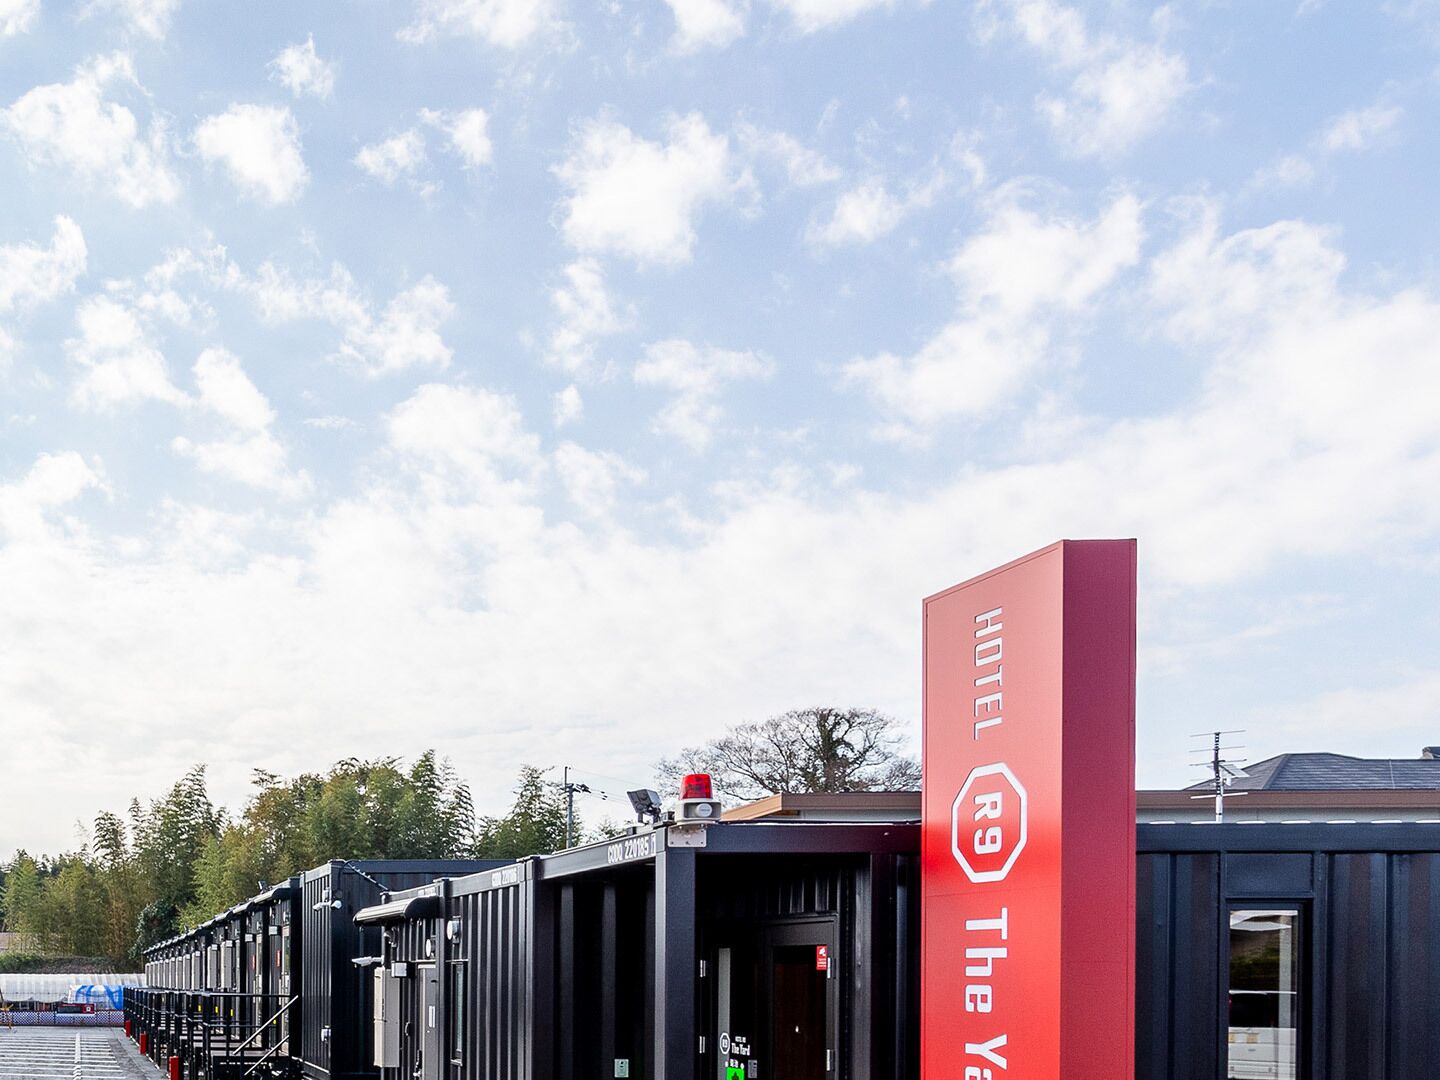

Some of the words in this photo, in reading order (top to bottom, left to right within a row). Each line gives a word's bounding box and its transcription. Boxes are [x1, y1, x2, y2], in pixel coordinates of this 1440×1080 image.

[974, 606, 1003, 741] HOTEL
[973, 791, 1003, 855] R9
[964, 906, 1008, 1014] The
